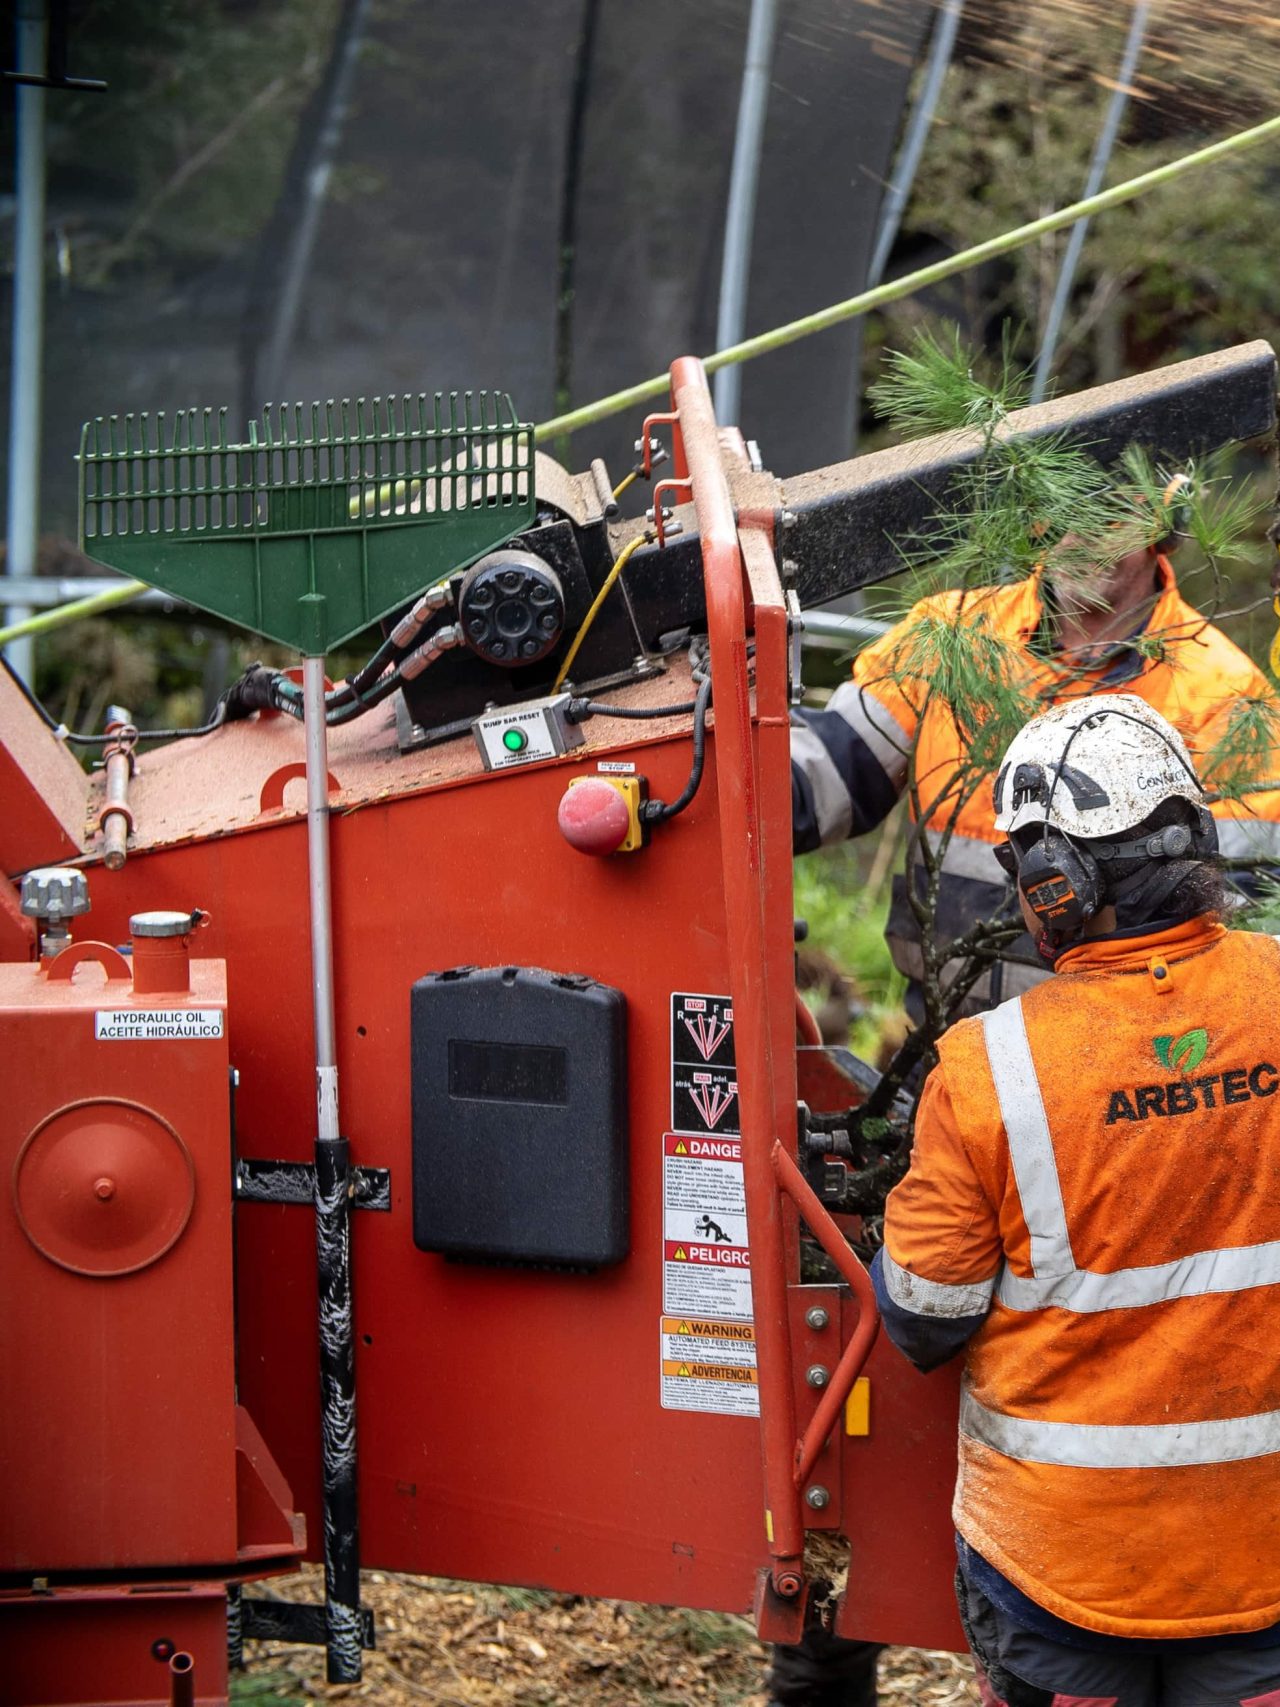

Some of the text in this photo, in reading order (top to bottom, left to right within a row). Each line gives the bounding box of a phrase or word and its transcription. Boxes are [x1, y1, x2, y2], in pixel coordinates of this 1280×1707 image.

[482, 711, 540, 728] BUMP BAR RESET
[677, 1010, 684, 1020] R
[713, 1004, 719, 1013] F
[113, 1012, 205, 1023] HYDRAULIC OIL
[99, 1026, 142, 1037] ACEITE
[1105, 1062, 1280, 1126] ARBTEC
[690, 1141, 741, 1158] DANGE
[691, 1323, 752, 1339] WARNING
[668, 1336, 709, 1345] AUTOMATED
[692, 1365, 752, 1381] ADVERTENCIA
